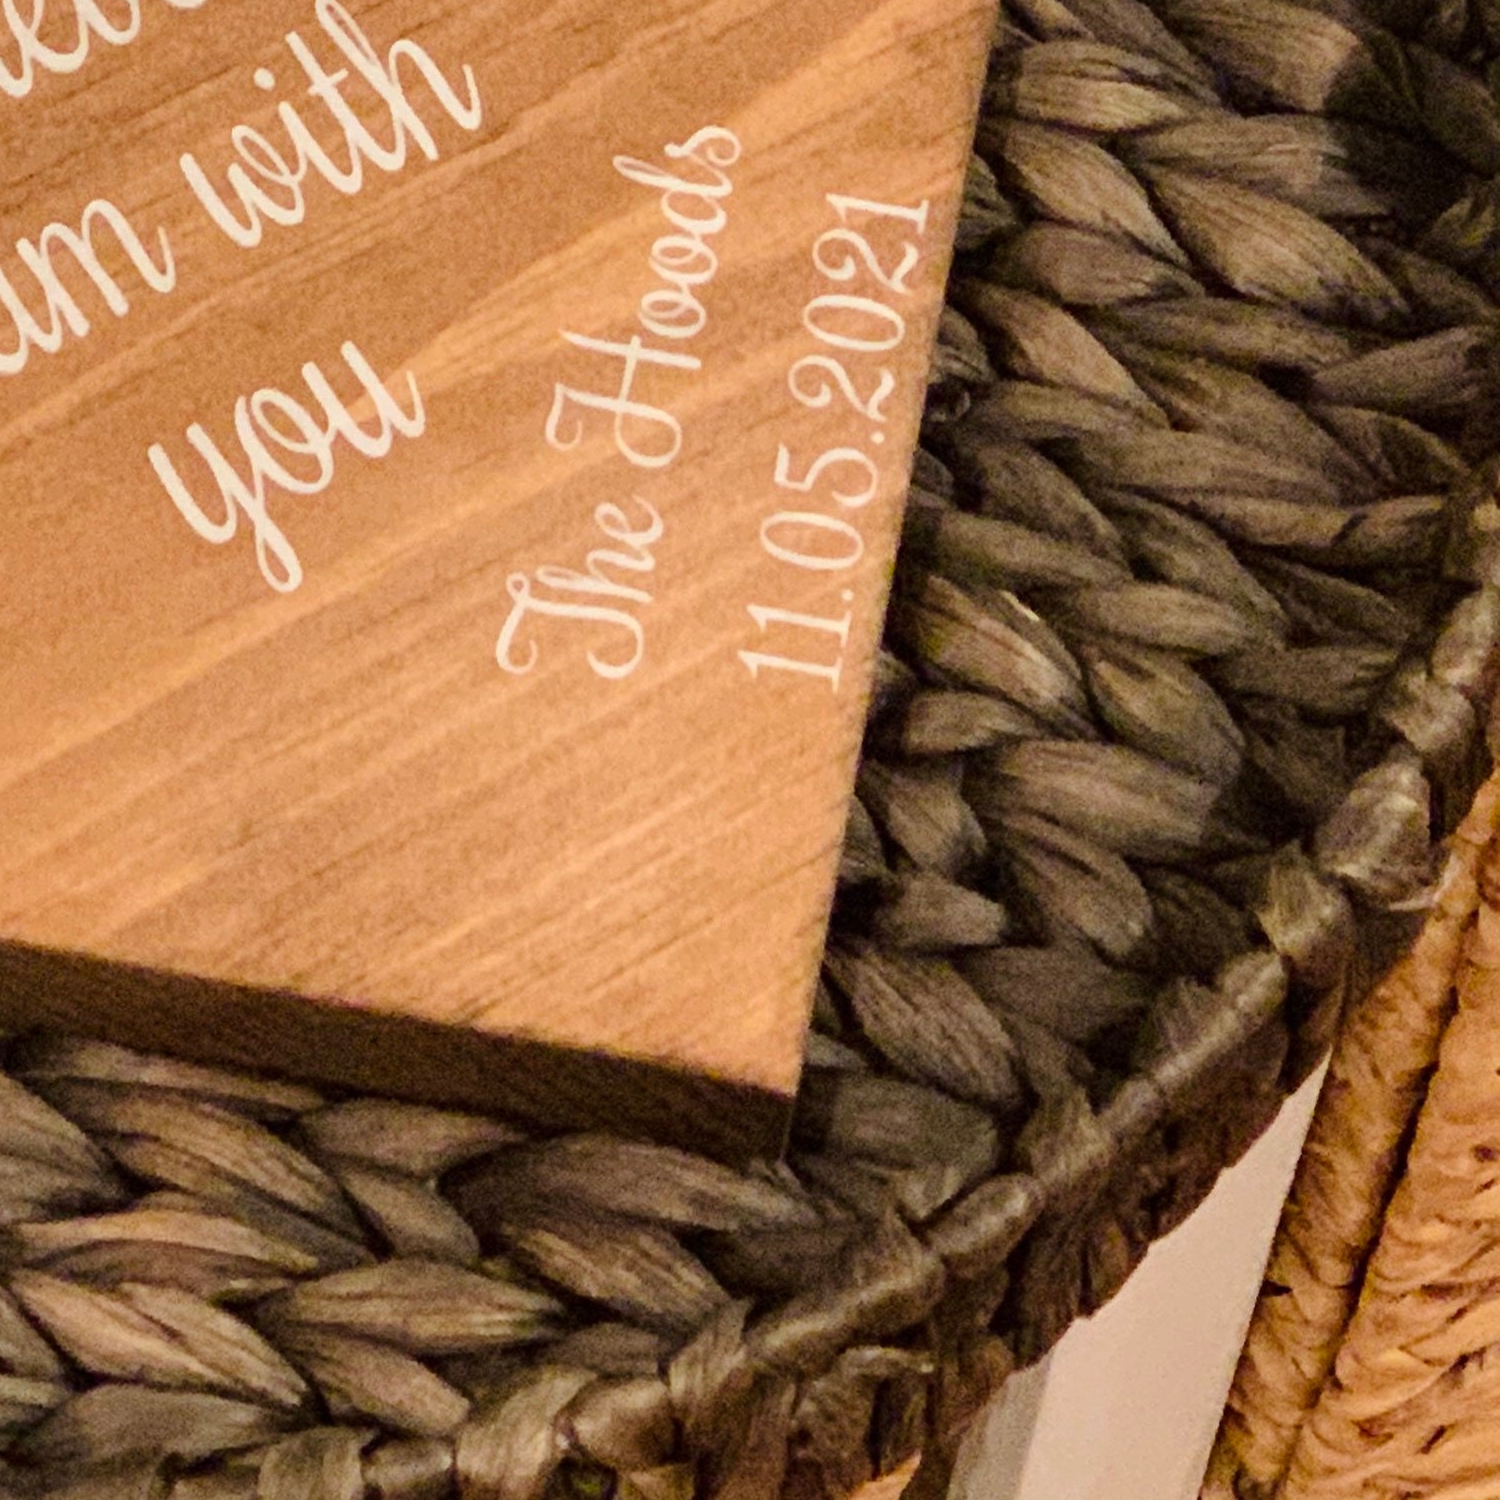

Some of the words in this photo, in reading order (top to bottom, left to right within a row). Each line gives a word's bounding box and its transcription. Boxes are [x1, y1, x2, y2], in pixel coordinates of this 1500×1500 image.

[544, 124, 742, 469] Hoods
[737, 192, 930, 694] 11.05.2021
[147, 340, 426, 593] you
[495, 494, 665, 680] The
